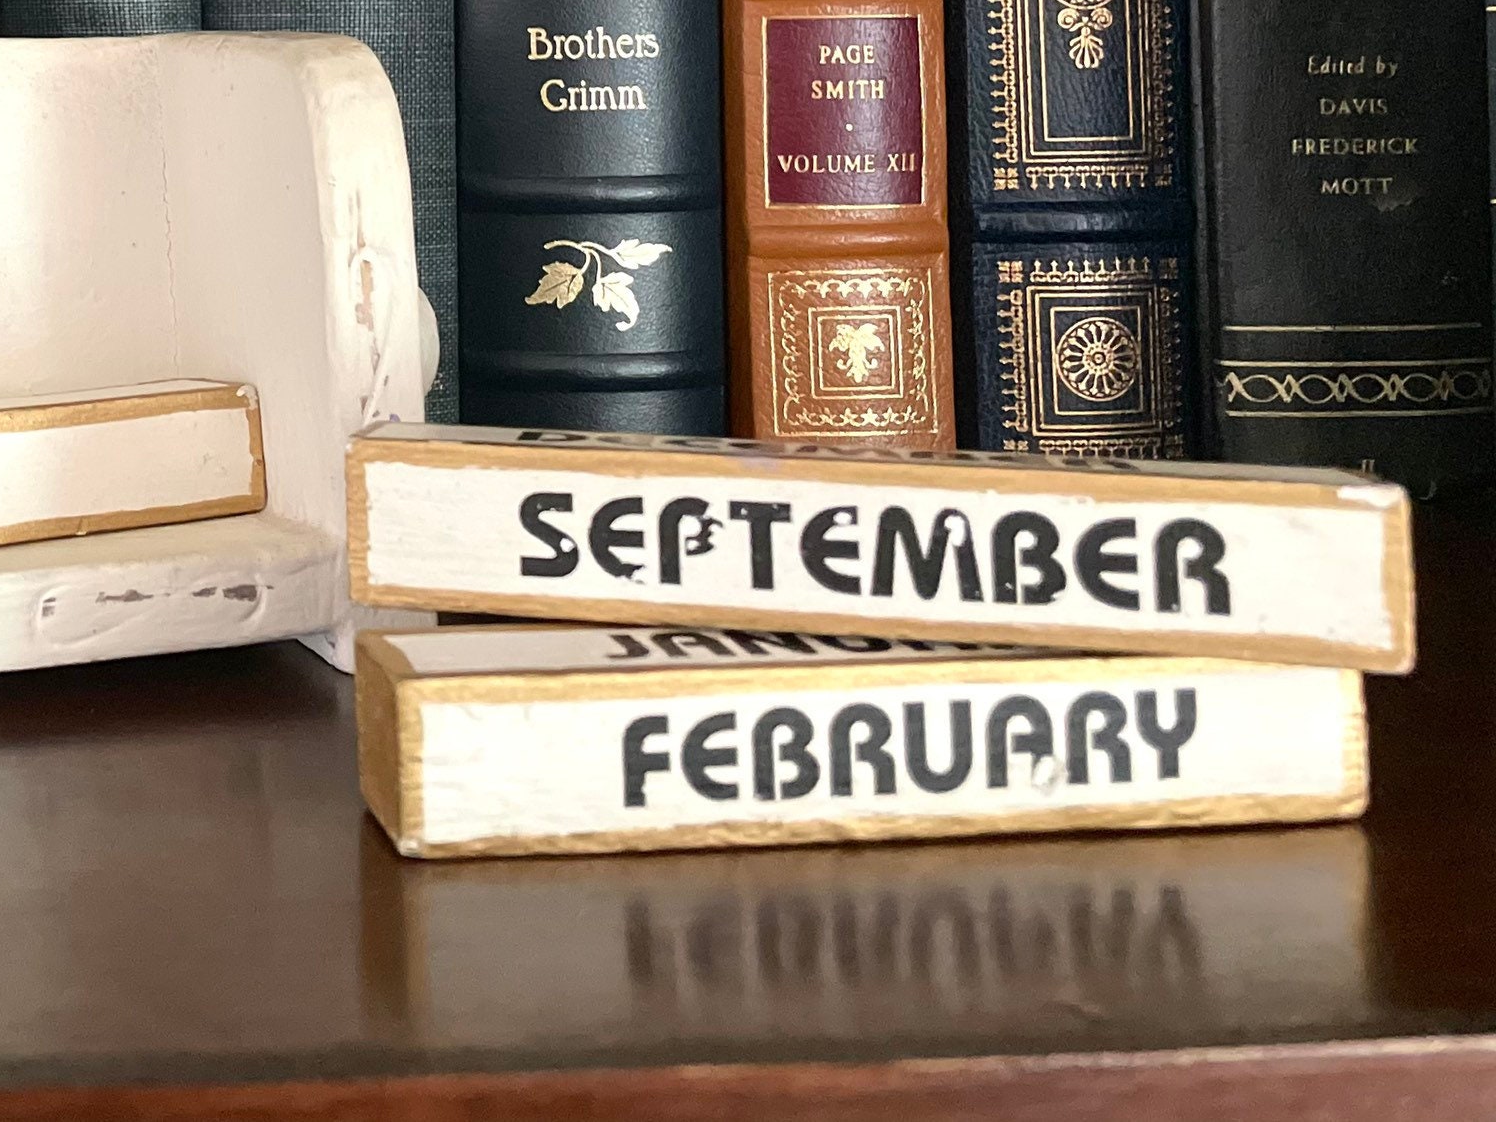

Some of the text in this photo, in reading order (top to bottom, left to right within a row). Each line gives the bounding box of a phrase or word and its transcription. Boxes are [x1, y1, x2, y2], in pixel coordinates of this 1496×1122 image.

[526, 25, 661, 61] Brothers
[818, 44, 876, 65] PAGE
[1307, 54, 1399, 78] Edited by
[539, 78, 649, 113] Grimm
[811, 79, 885, 100] SMITH
[1319, 97, 1389, 116] DAVIS
[1291, 137, 1419, 156] FREDERICK
[777, 152, 917, 174] VOLUME XII
[1320, 177, 1393, 196] MOTT
[518, 491, 1233, 617] SEPTEMBER
[621, 688, 1198, 809] FEBRUARY
